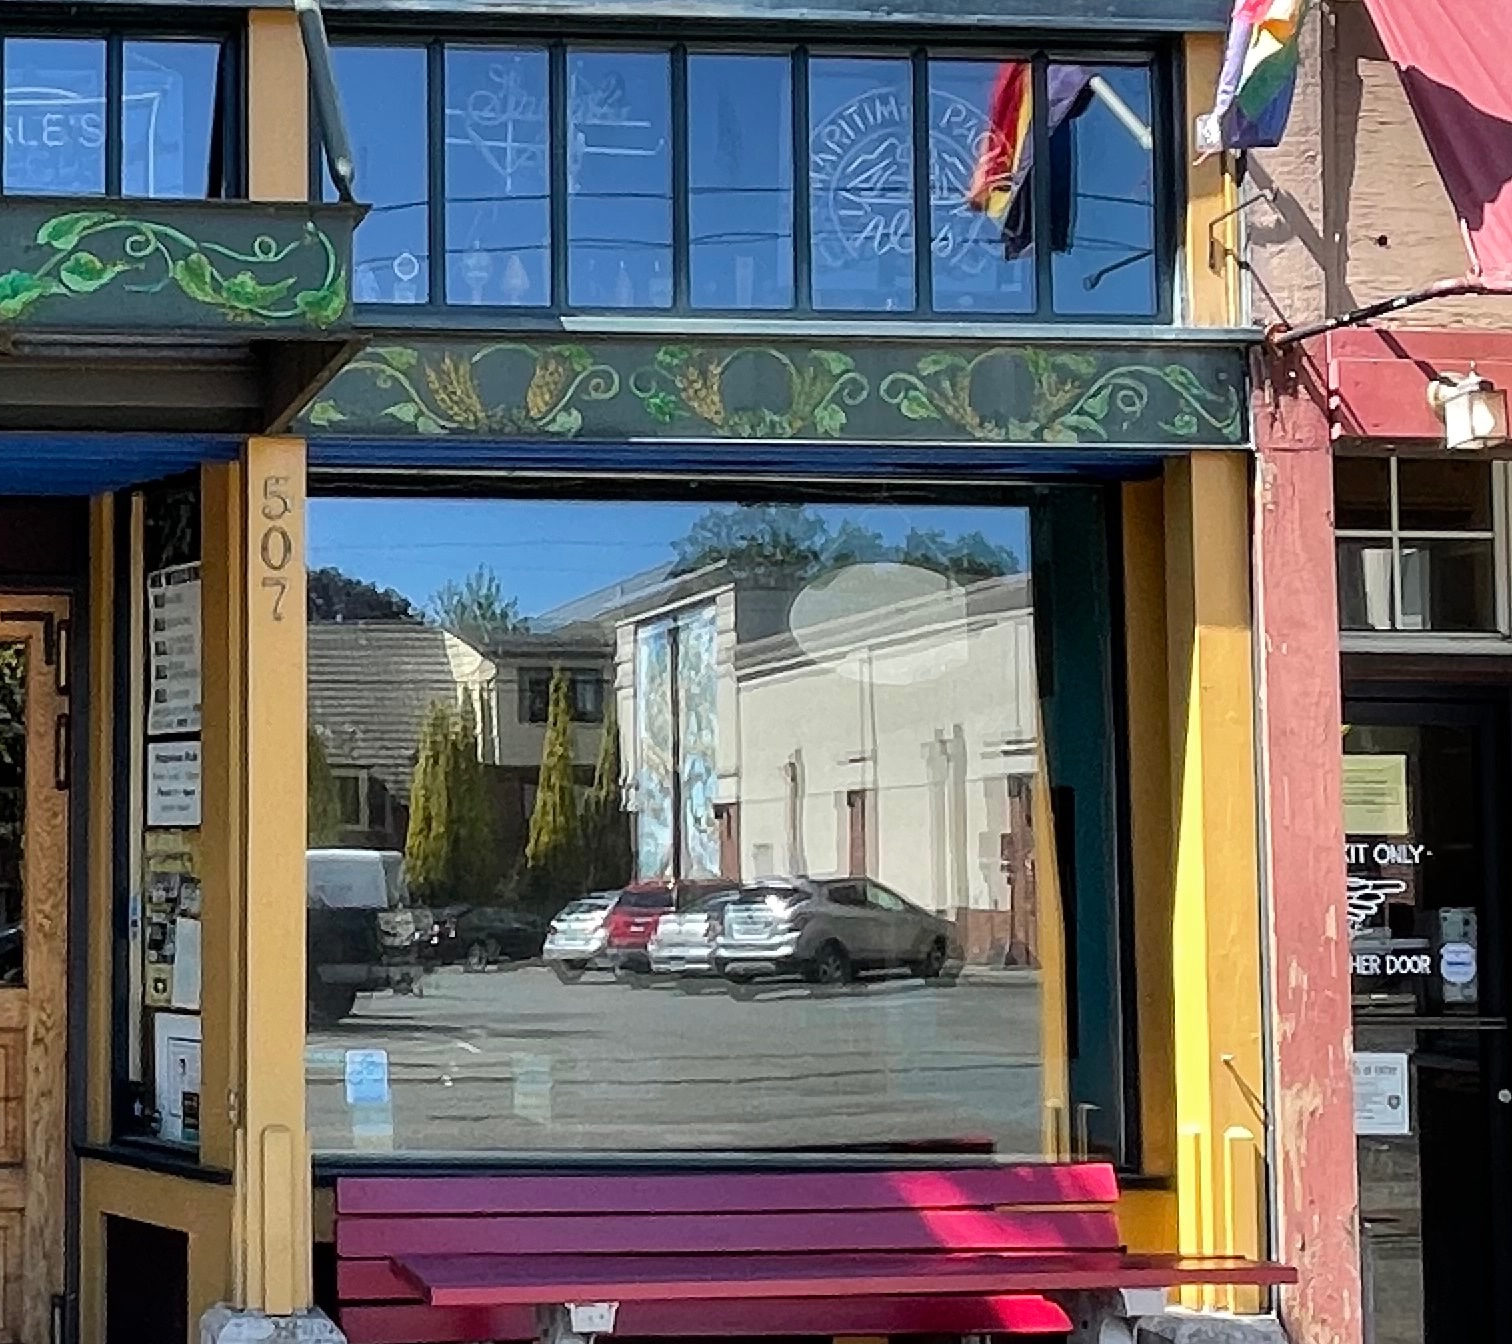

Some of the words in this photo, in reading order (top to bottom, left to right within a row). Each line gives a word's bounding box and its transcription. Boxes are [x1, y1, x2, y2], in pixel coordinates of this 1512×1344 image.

[260, 476, 293, 622] 507
[1373, 843, 1425, 864] ONLY
[1349, 954, 1382, 975] HER
[1386, 954, 1432, 975] DOOR
